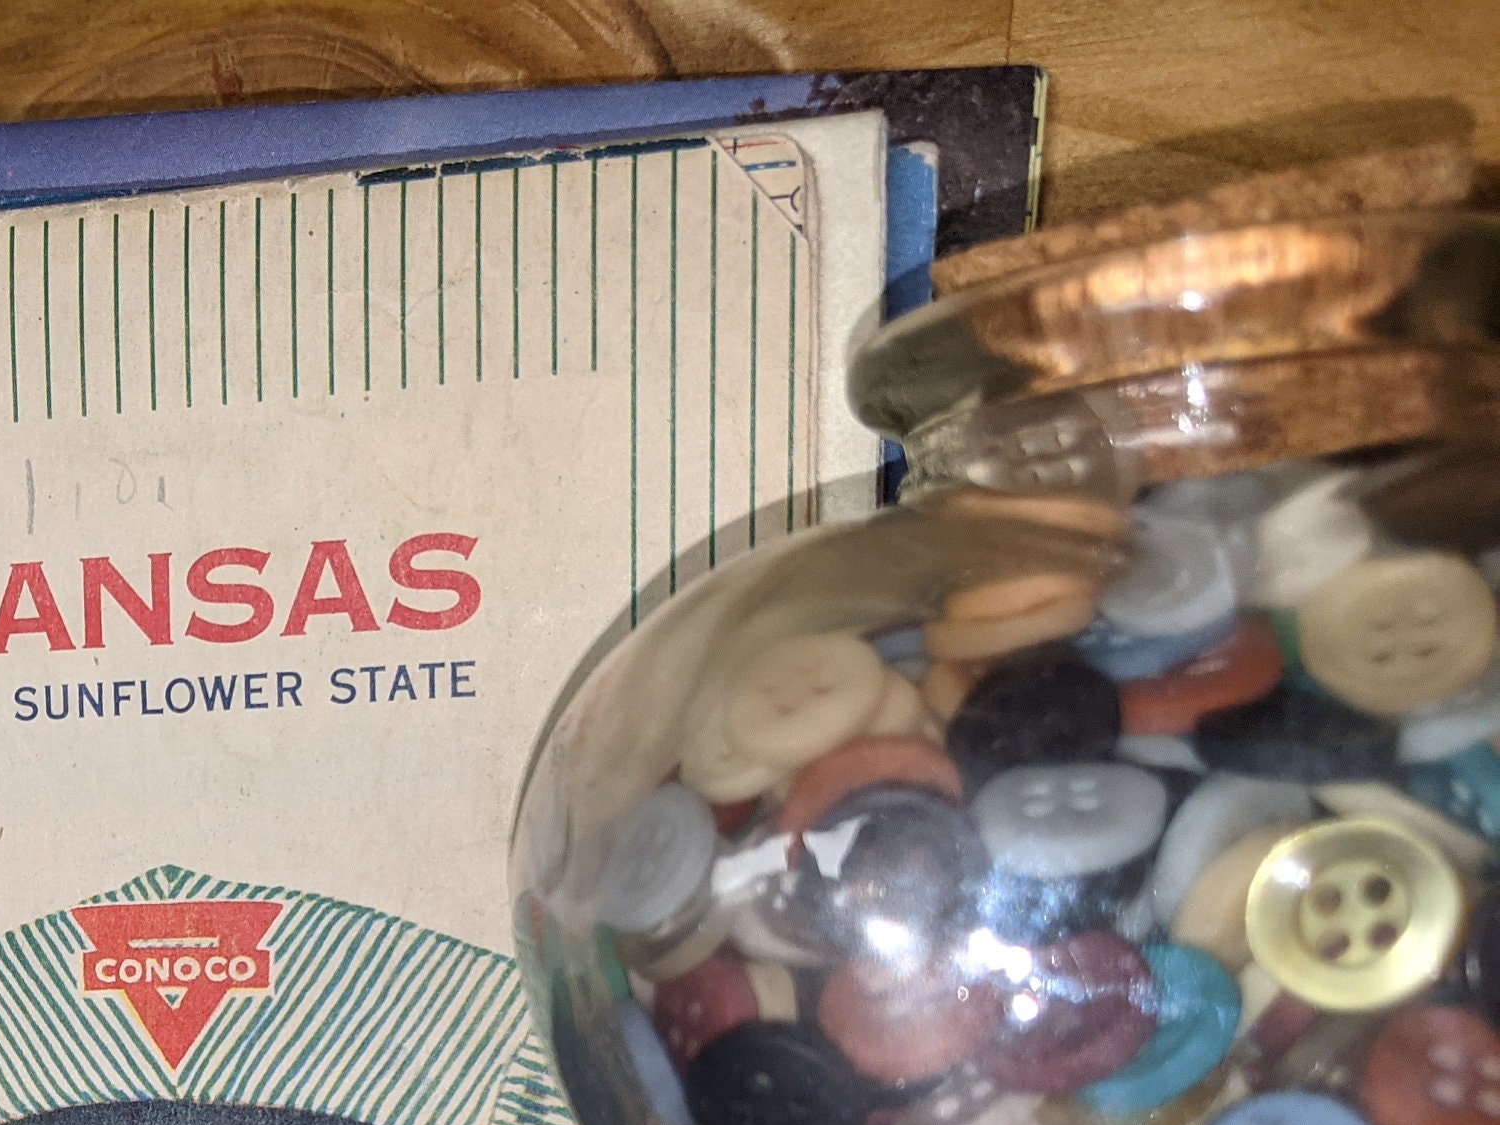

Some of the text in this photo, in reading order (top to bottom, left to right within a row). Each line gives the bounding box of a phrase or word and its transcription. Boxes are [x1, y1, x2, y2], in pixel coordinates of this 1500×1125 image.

[14, 671, 303, 722] SUNFLOWER
[330, 660, 477, 705] STATE
[95, 954, 257, 984] CONOCO
